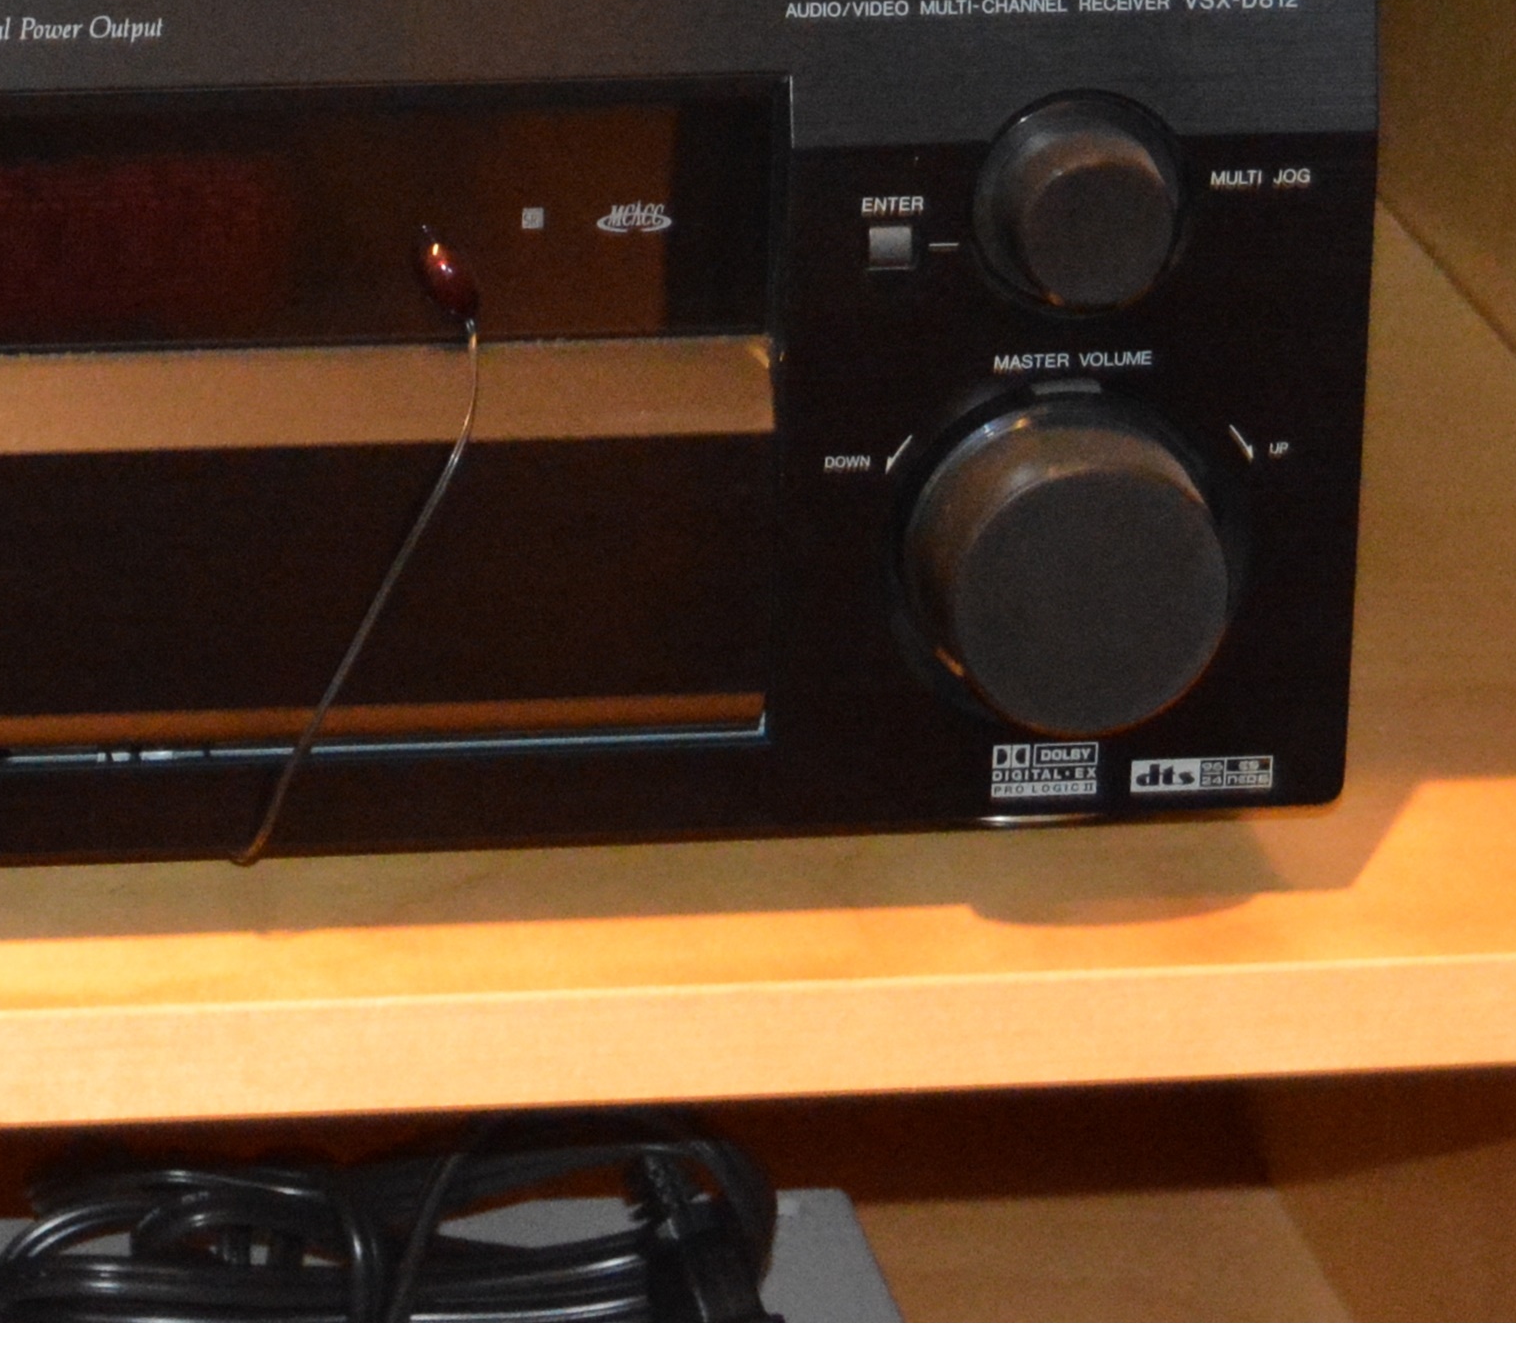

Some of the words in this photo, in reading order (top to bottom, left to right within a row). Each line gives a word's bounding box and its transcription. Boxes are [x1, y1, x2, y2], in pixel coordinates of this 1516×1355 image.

[785, 0, 909, 18] AUDIO/VIDEO
[19, 17, 83, 40] Power
[89, 15, 164, 42] Output
[1210, 169, 1262, 186] MULTI
[1272, 168, 1311, 185] JOG
[861, 196, 925, 214] ENTER
[993, 354, 1070, 371] MASTER
[1079, 350, 1153, 367] VOLUME
[1269, 440, 1289, 457] UP
[824, 454, 871, 471] DOWN
[1040, 747, 1092, 763] DOLBY
[991, 770, 1062, 783] DIGITAL
[1074, 767, 1098, 780] EX
[1135, 763, 1196, 788] dts
[993, 785, 1025, 796] PRO
[1031, 783, 1080, 795] LOGIC
